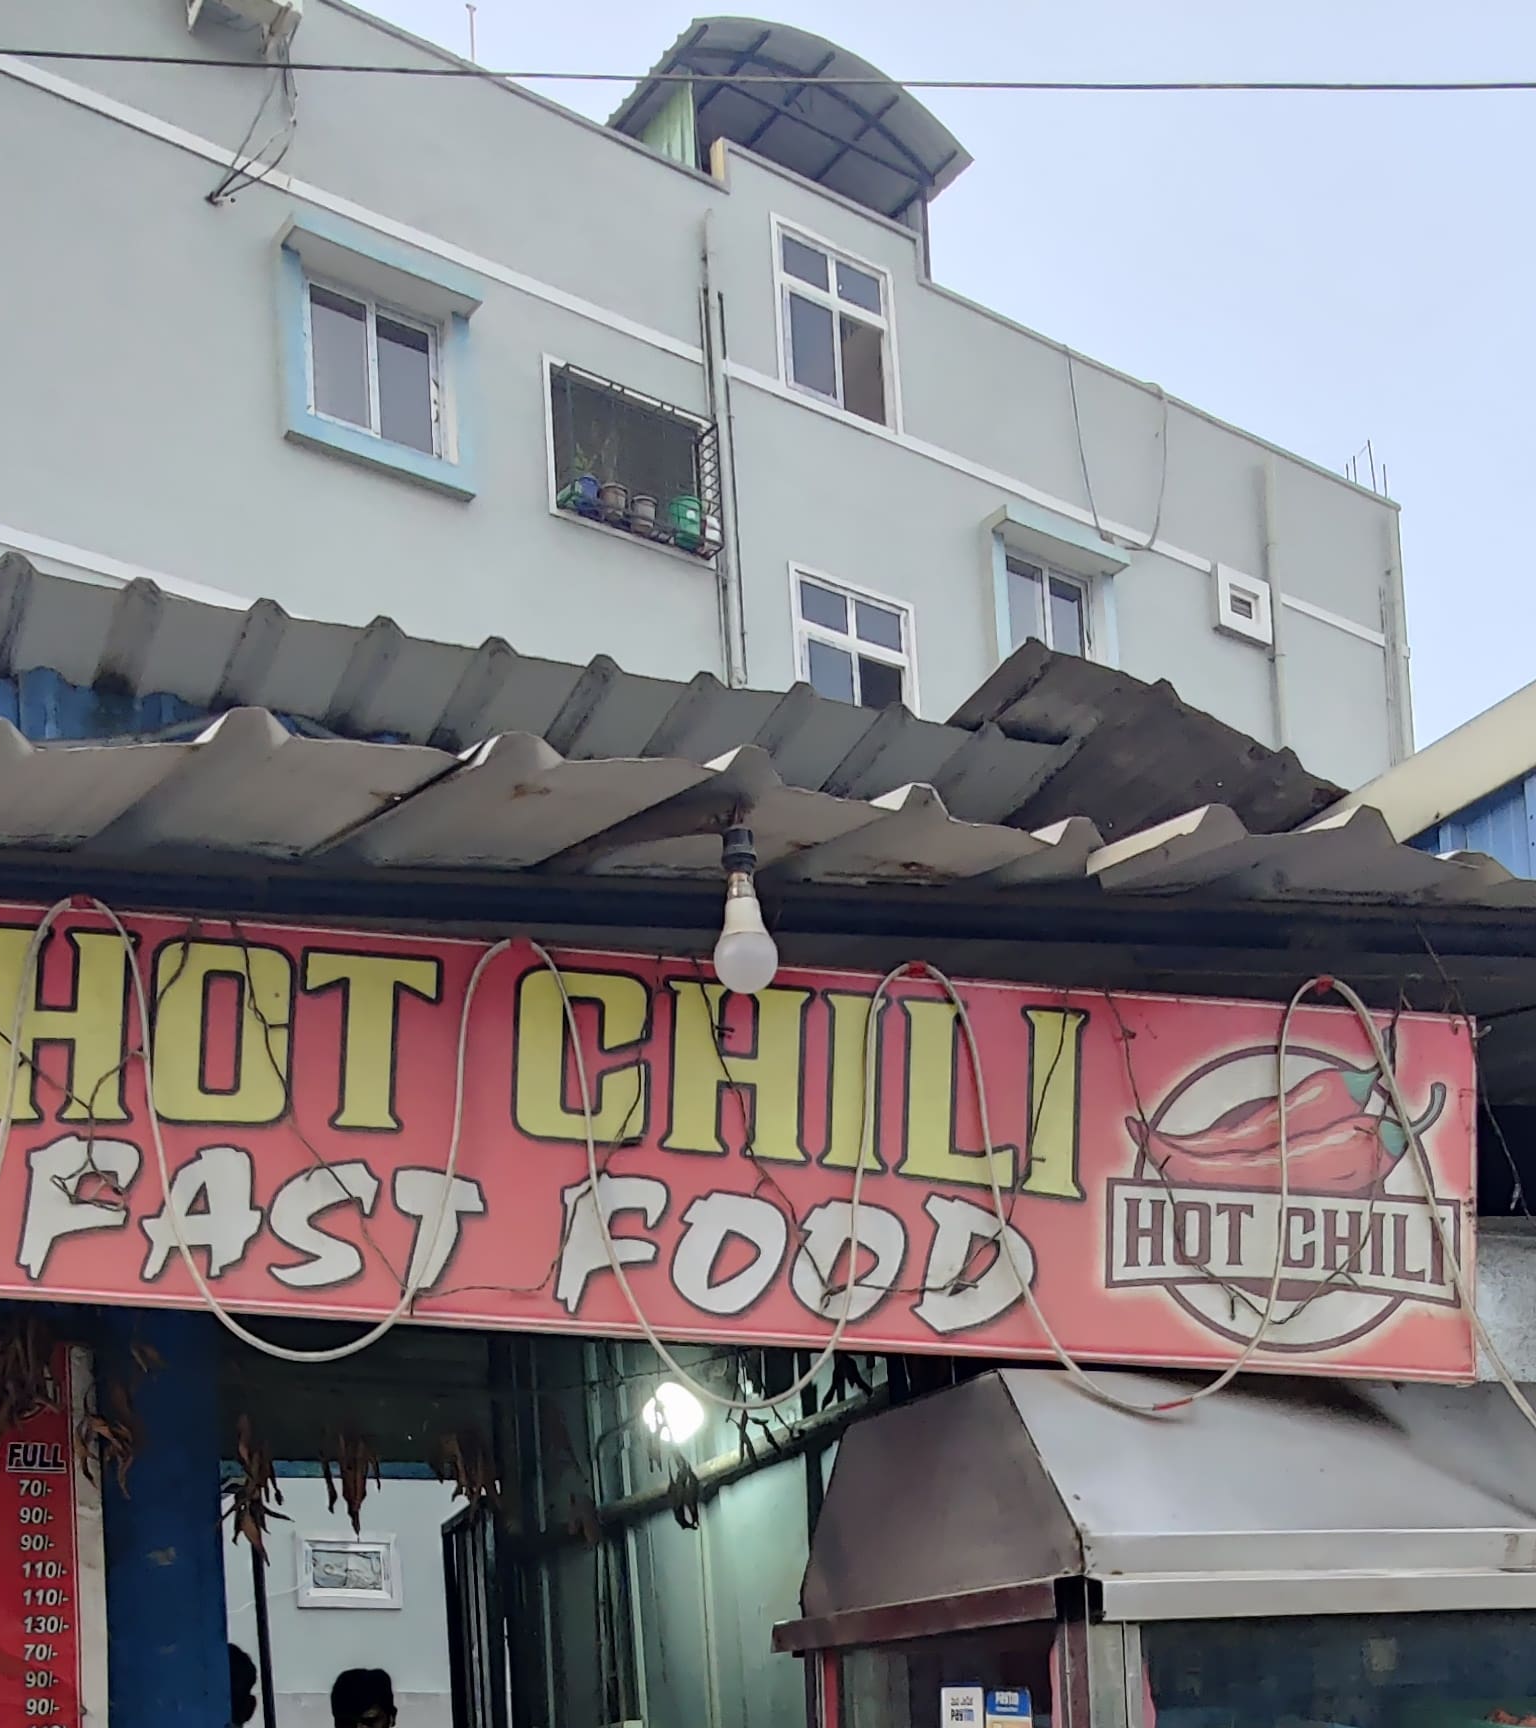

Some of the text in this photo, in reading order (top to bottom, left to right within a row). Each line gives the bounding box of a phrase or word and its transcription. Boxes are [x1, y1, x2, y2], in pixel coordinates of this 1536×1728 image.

[513, 967, 1088, 1202] CHILI
[17, 1133, 1035, 1335] FAST FOOD
[1123, 1195, 1450, 1285] HOT CHILI
[8, 1443, 65, 1467] FULL
[19, 1479, 53, 1497] 70/-
[19, 1506, 54, 1525] 90/-
[22, 1561, 67, 1579] 110/-
[24, 1615, 70, 1634] 130/-
[24, 1643, 58, 1661] 70/-
[25, 1670, 59, 1689] 90/-
